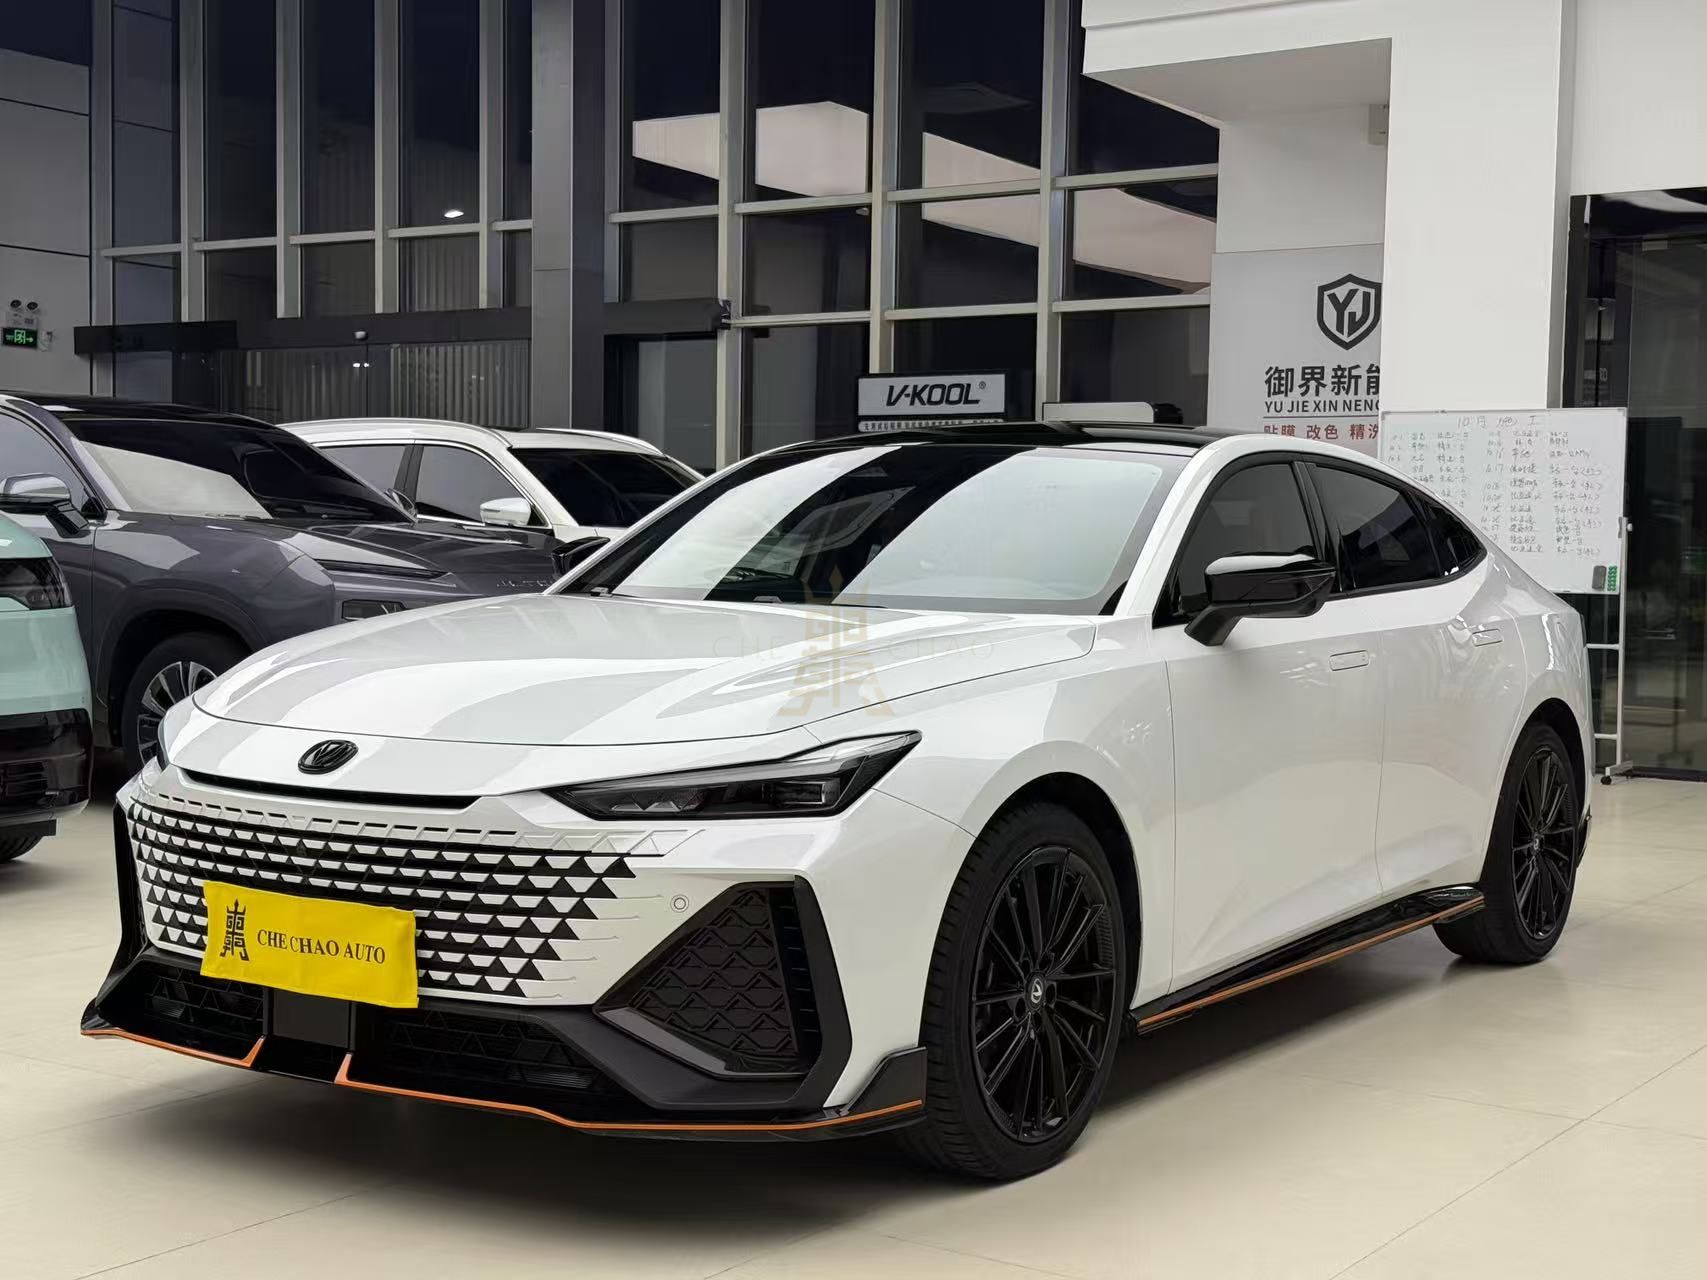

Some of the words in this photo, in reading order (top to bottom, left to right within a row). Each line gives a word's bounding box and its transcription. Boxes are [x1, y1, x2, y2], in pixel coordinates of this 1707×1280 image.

[1265, 401, 1283, 413] YU
[1287, 400, 1310, 413] JIE
[1313, 400, 1338, 412] XIN
[1342, 399, 1379, 412] NEN
[1306, 424, 1338, 440] 改色
[257, 929, 288, 950] CHE
[289, 935, 340, 956] CHAO
[343, 942, 386, 964] AUTO
